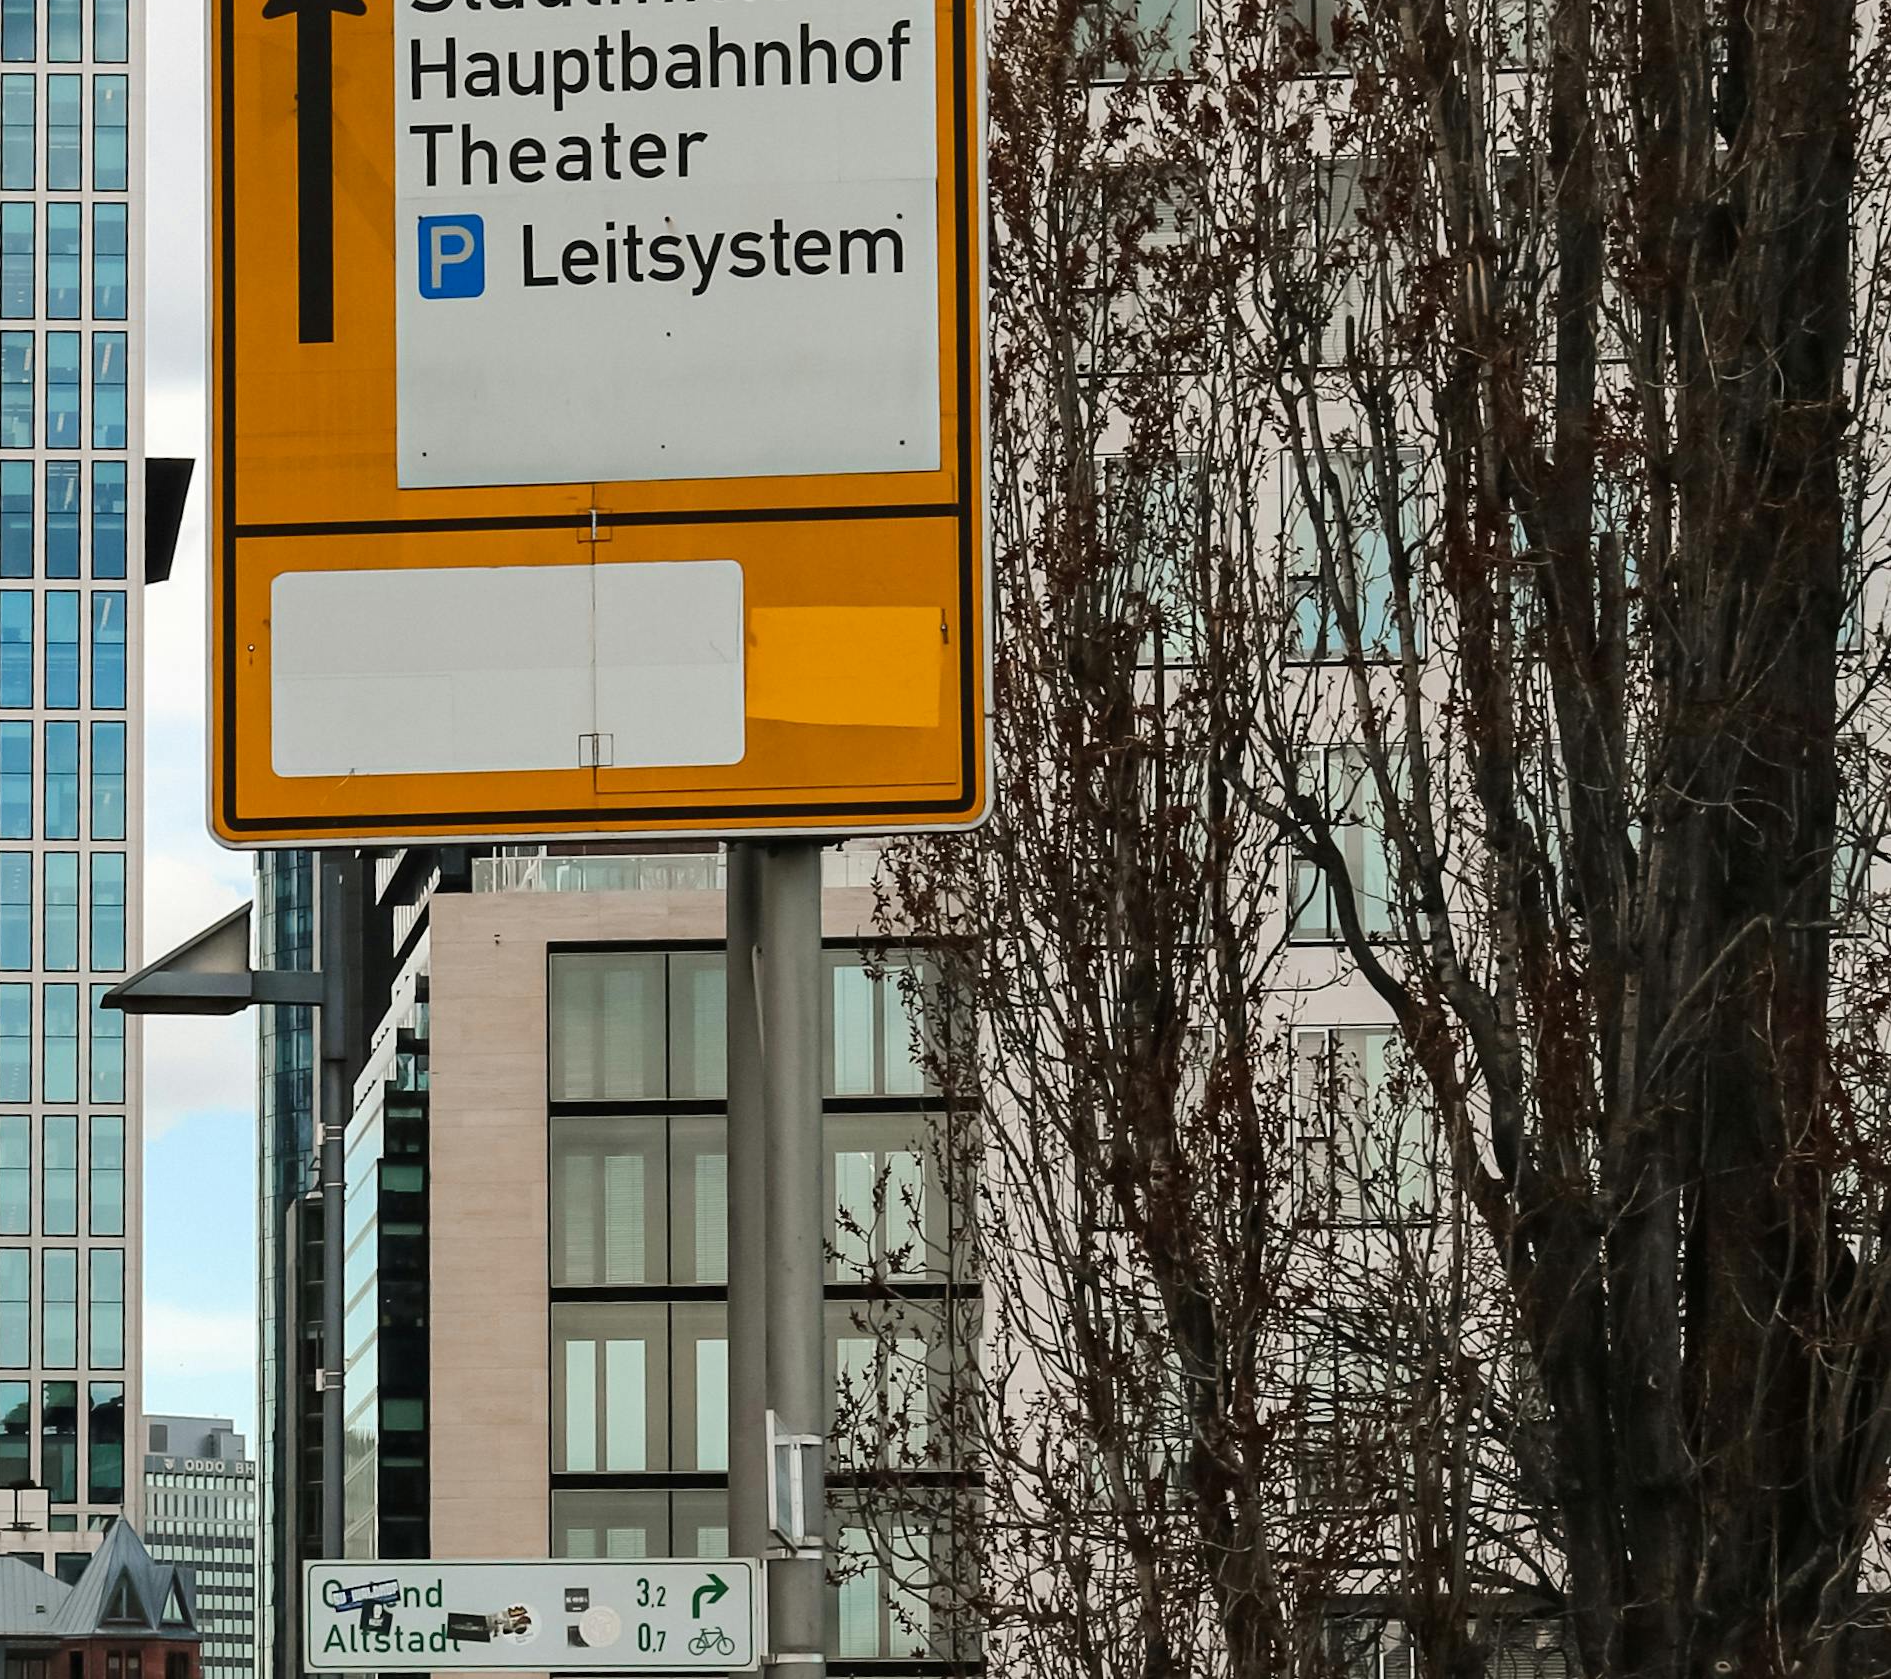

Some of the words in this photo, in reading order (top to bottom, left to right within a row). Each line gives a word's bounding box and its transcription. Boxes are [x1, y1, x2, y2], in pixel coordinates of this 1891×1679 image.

[410, 20, 910, 111] Hauptbahnhof
[410, 122, 708, 187] Theater
[430, 225, 475, 288] P
[522, 218, 904, 296] Leitsystem
[185, 1459, 225, 1473] ODDO
